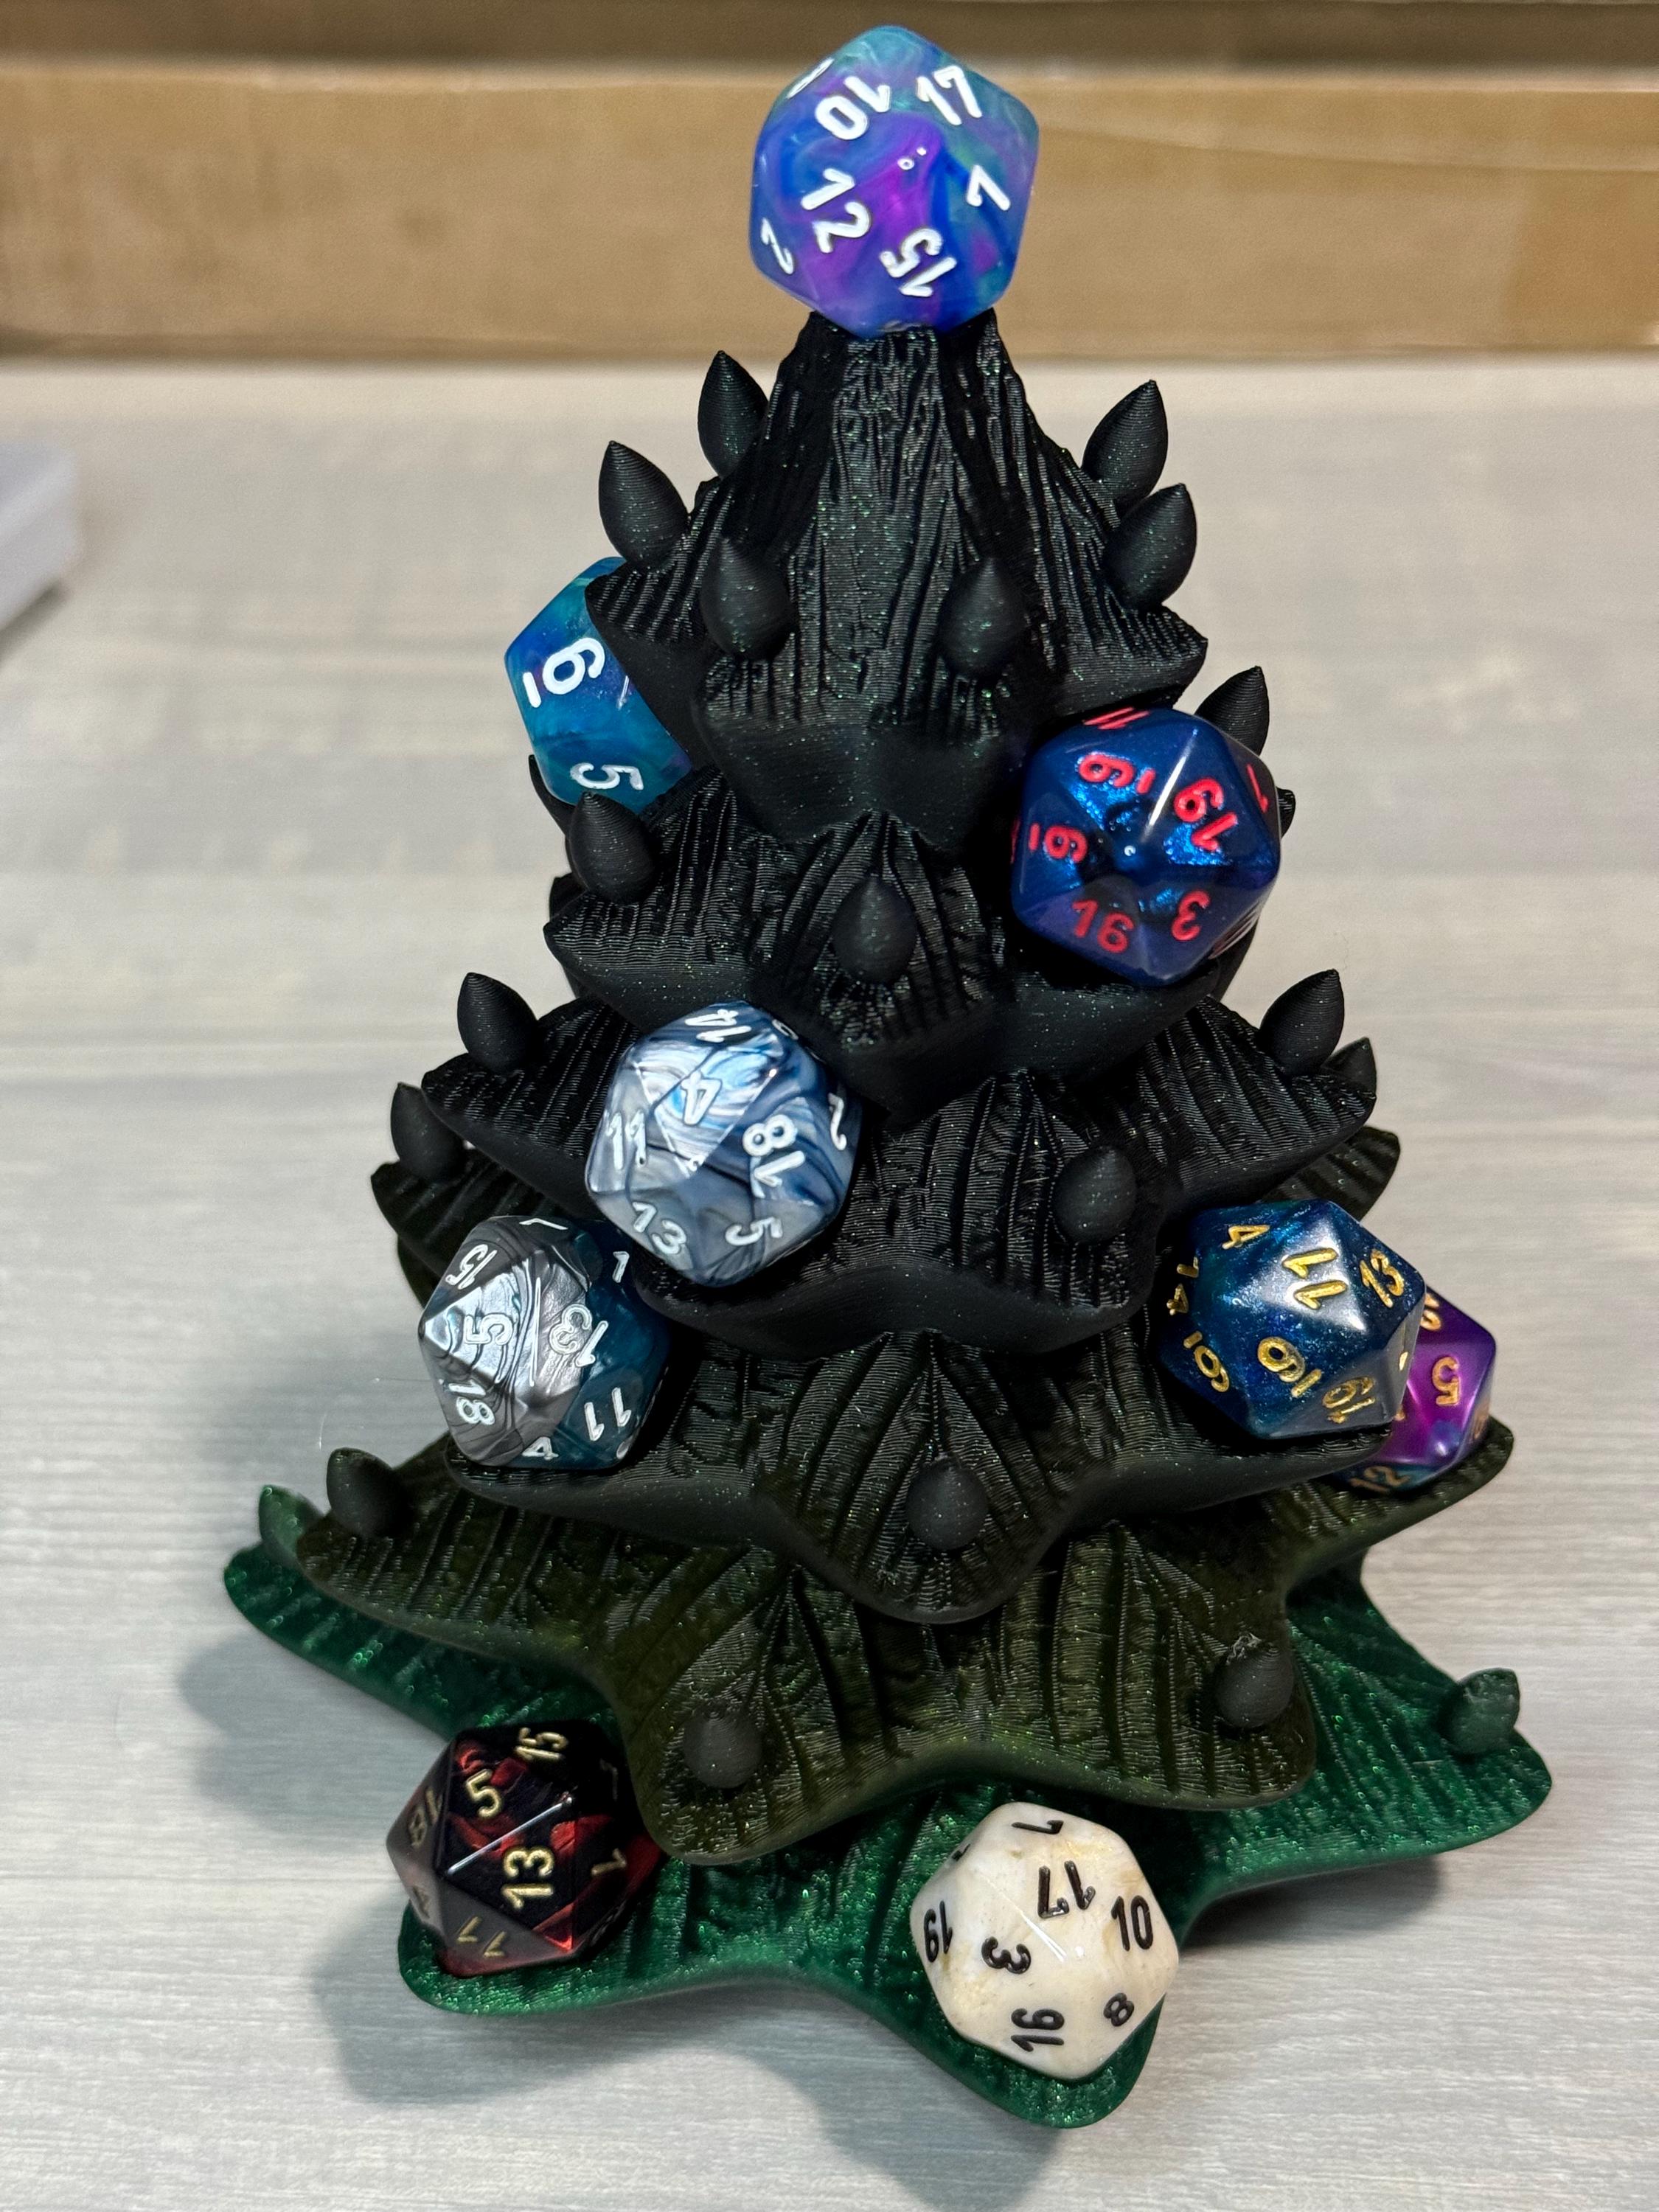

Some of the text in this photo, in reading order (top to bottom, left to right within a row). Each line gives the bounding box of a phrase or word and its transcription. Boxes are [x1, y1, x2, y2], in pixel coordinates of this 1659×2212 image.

[815, 75, 891, 140] 10
[916, 64, 982, 125] 17
[801, 167, 872, 253] 12
[880, 228, 957, 297] 15
[570, 762, 644, 790] 5
[1174, 778, 1239, 852] 19
[1072, 899, 1134, 953] 16
[1172, 890, 1211, 942] 3
[681, 1069, 723, 1126] 4
[606, 1112, 647, 1169] 11
[742, 1114, 805, 1187] 18
[632, 1202, 687, 1254] 13
[725, 1217, 784, 1246] 5
[1222, 1224, 1270, 1250] 4
[445, 1244, 498, 1290] 15
[1281, 1247, 1349, 1310] 11
[1359, 1249, 1405, 1309] 13
[463, 1312, 514, 1346] 5
[448, 1380, 495, 1425] 18
[1432, 1356, 1461, 1406] 5
[584, 1387, 632, 1441] 11
[522, 1436, 559, 1461] 4
[516, 1727, 569, 1760] 15
[465, 1768, 502, 1818] 5
[501, 1847, 554, 1910] 13
[1037, 1860, 1096, 1918] 17
[923, 1900, 953, 1964] 19
[1110, 1895, 1154, 1952] 10
[981, 1936, 1032, 1975] 3
[1011, 2008, 1065, 2052] 16
[1102, 1992, 1135, 2027] 8
